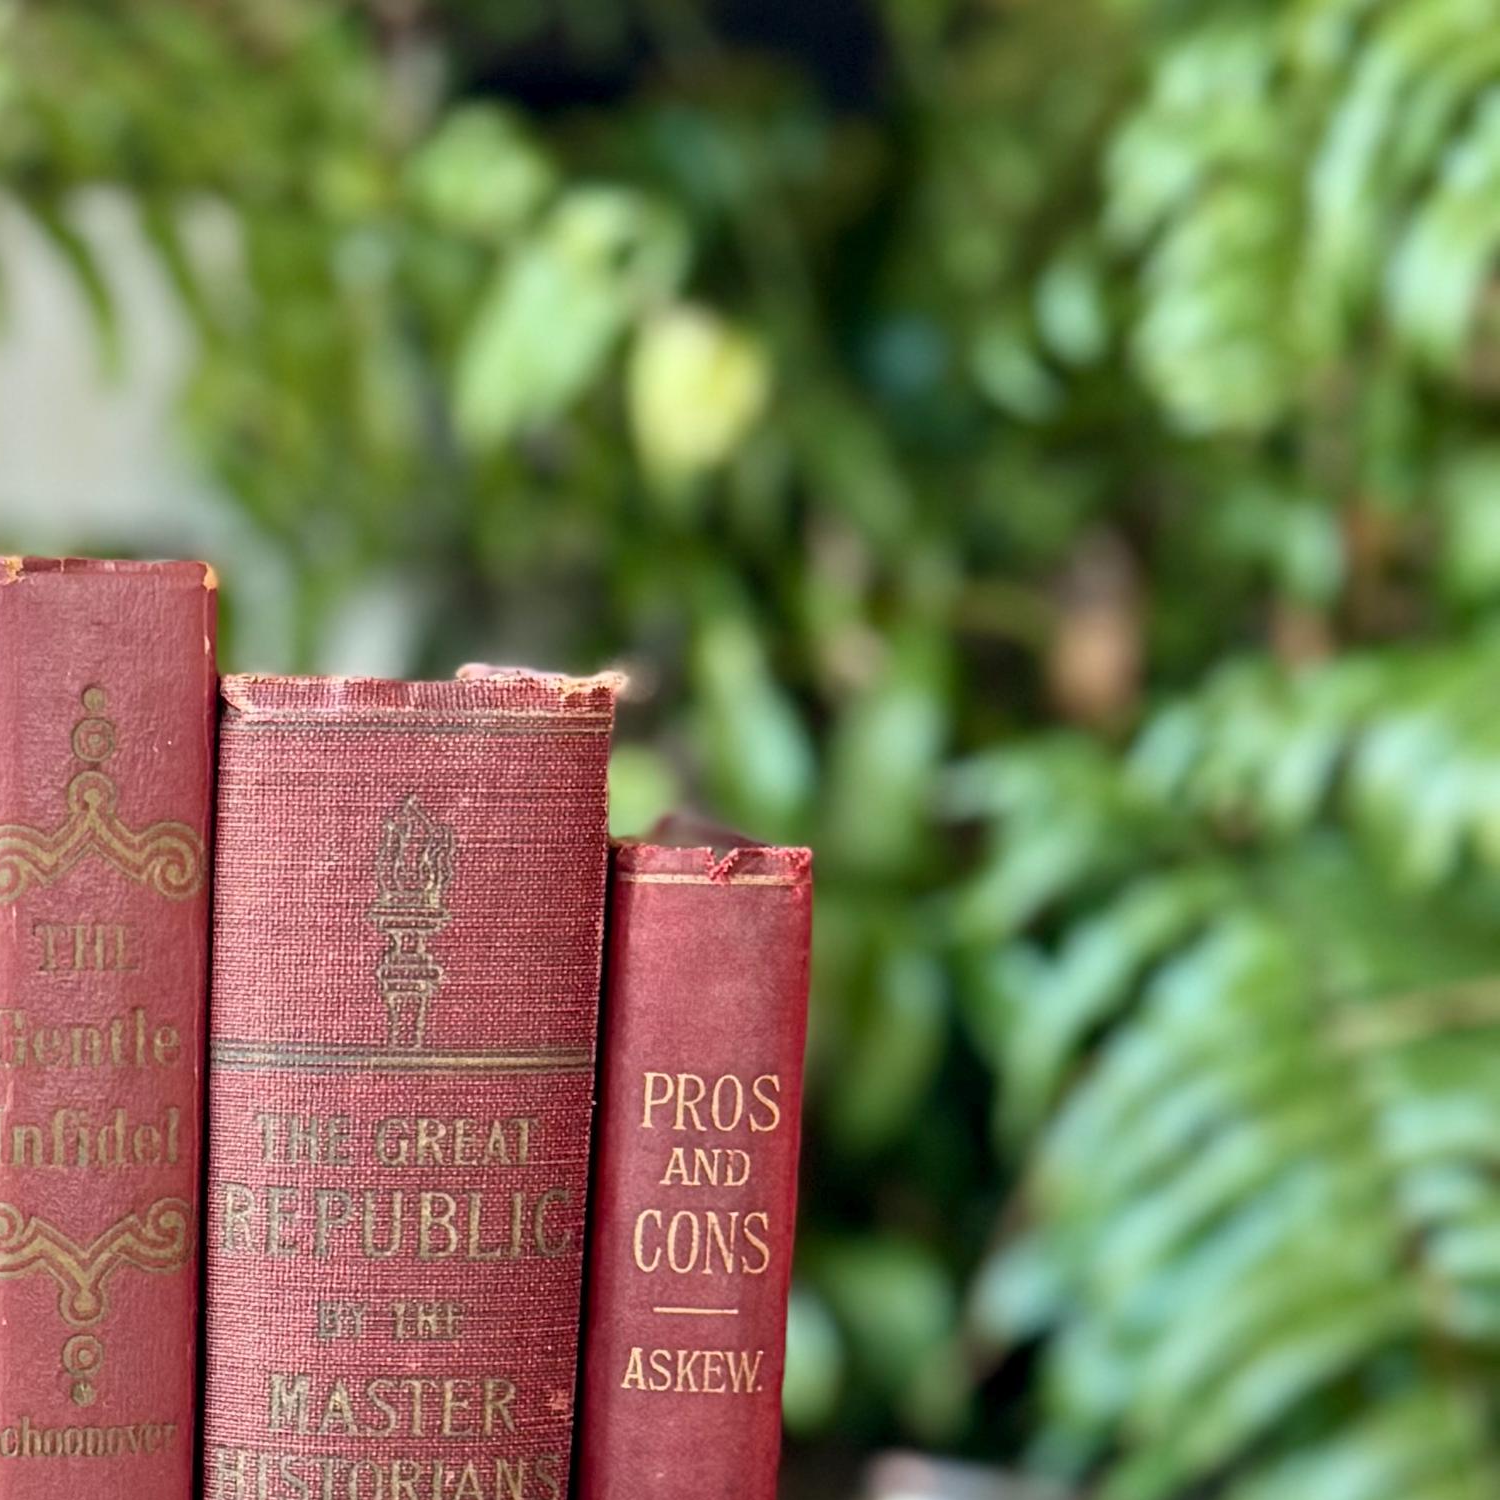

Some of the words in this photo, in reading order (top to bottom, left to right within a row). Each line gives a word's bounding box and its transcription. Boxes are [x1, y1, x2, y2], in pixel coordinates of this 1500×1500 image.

[641, 1071, 780, 1133] PROS
[256, 1113, 353, 1167] THE
[375, 1114, 538, 1167] GREAT
[659, 1147, 751, 1186] AND
[219, 1182, 572, 1261] REPUBLIC
[633, 1209, 770, 1275] CONS
[316, 1299, 366, 1339] BY
[393, 1299, 465, 1340] THE
[620, 1347, 764, 1393] ASKEW.
[268, 1372, 516, 1438] MASTER
